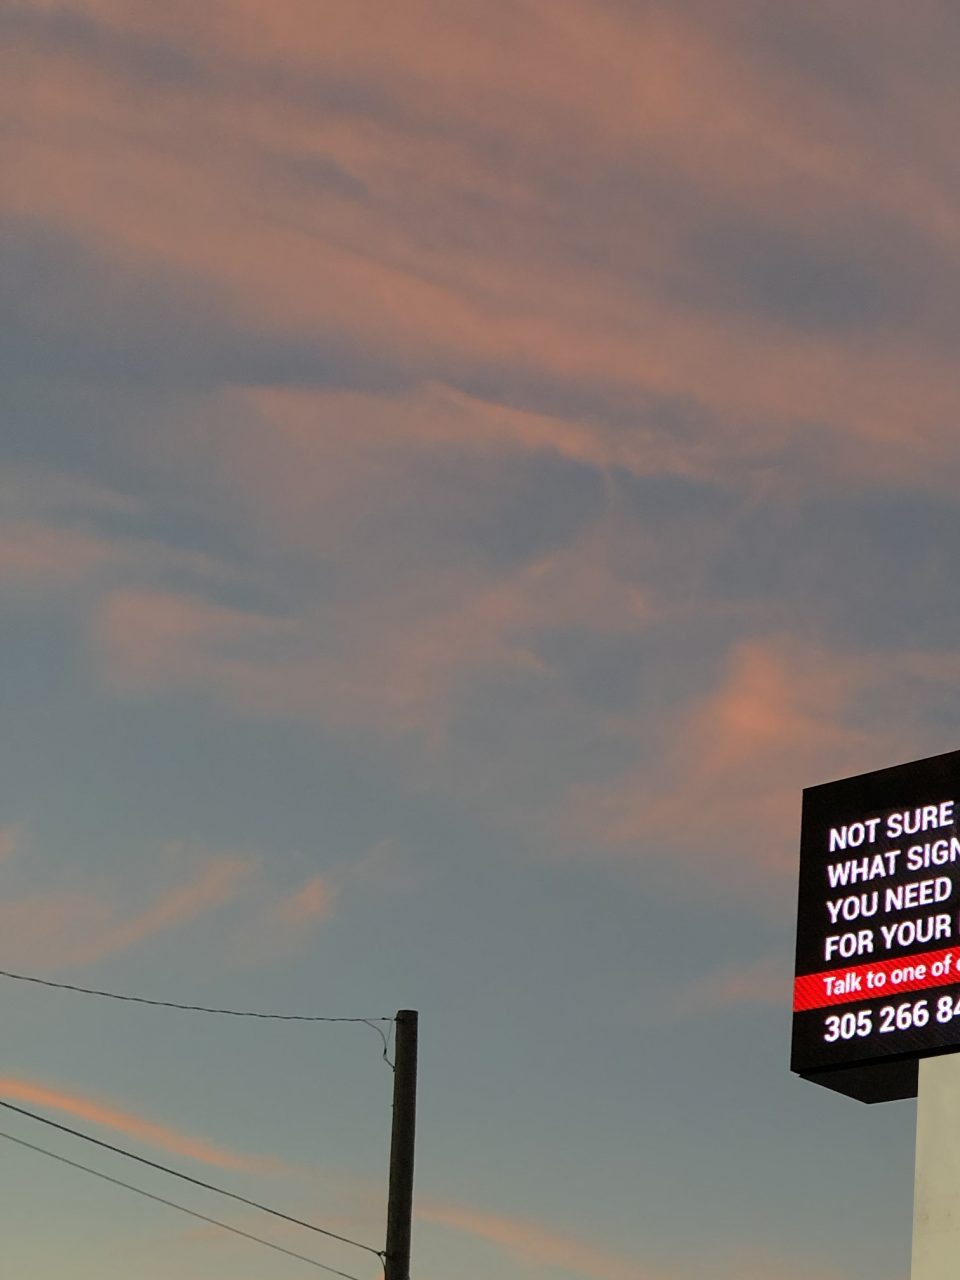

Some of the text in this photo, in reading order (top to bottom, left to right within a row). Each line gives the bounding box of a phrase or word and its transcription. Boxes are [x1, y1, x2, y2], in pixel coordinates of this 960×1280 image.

[829, 801, 955, 852] NOT SURE
[827, 850, 902, 888] WHAT
[826, 876, 953, 924] YOU NEED
[825, 930, 874, 962] FOR
[880, 916, 952, 950] YOUR
[822, 971, 862, 996] Talk
[866, 970, 887, 989] to
[890, 964, 927, 985] one
[931, 953, 953, 977] of
[823, 1009, 873, 1043] 305
[879, 1000, 929, 1033] 266
